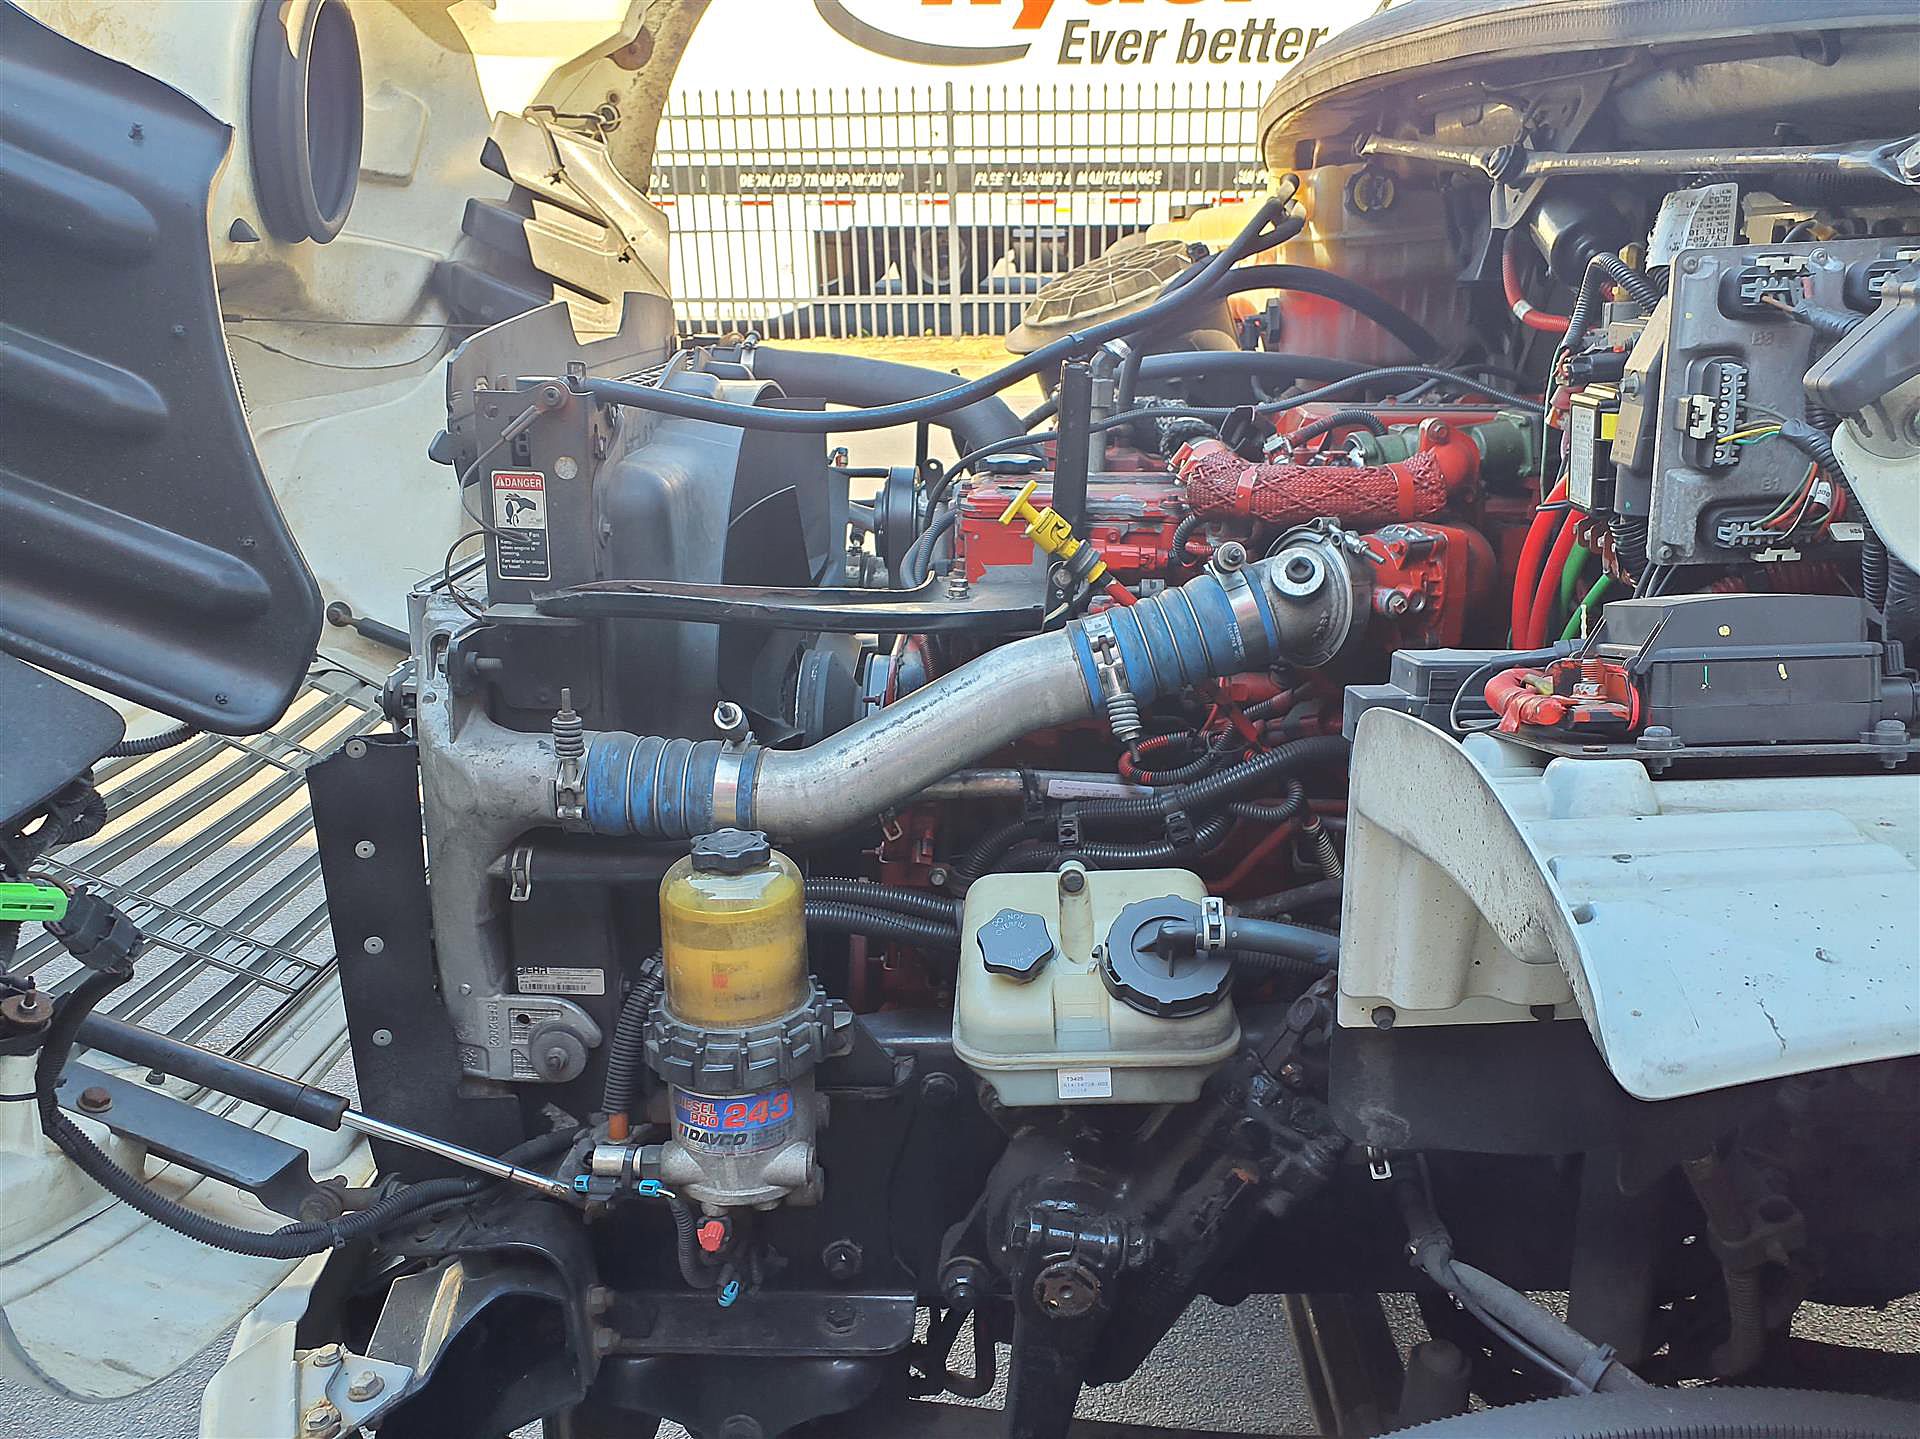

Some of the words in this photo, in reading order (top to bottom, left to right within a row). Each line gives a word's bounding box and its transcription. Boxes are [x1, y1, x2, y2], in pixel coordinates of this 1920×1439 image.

[1058, 19, 1167, 65] Ever
[1177, 18, 1329, 64] better
[505, 477, 542, 488] DANGER
[690, 1111, 719, 1128] PRO
[723, 1090, 791, 1129] 243
